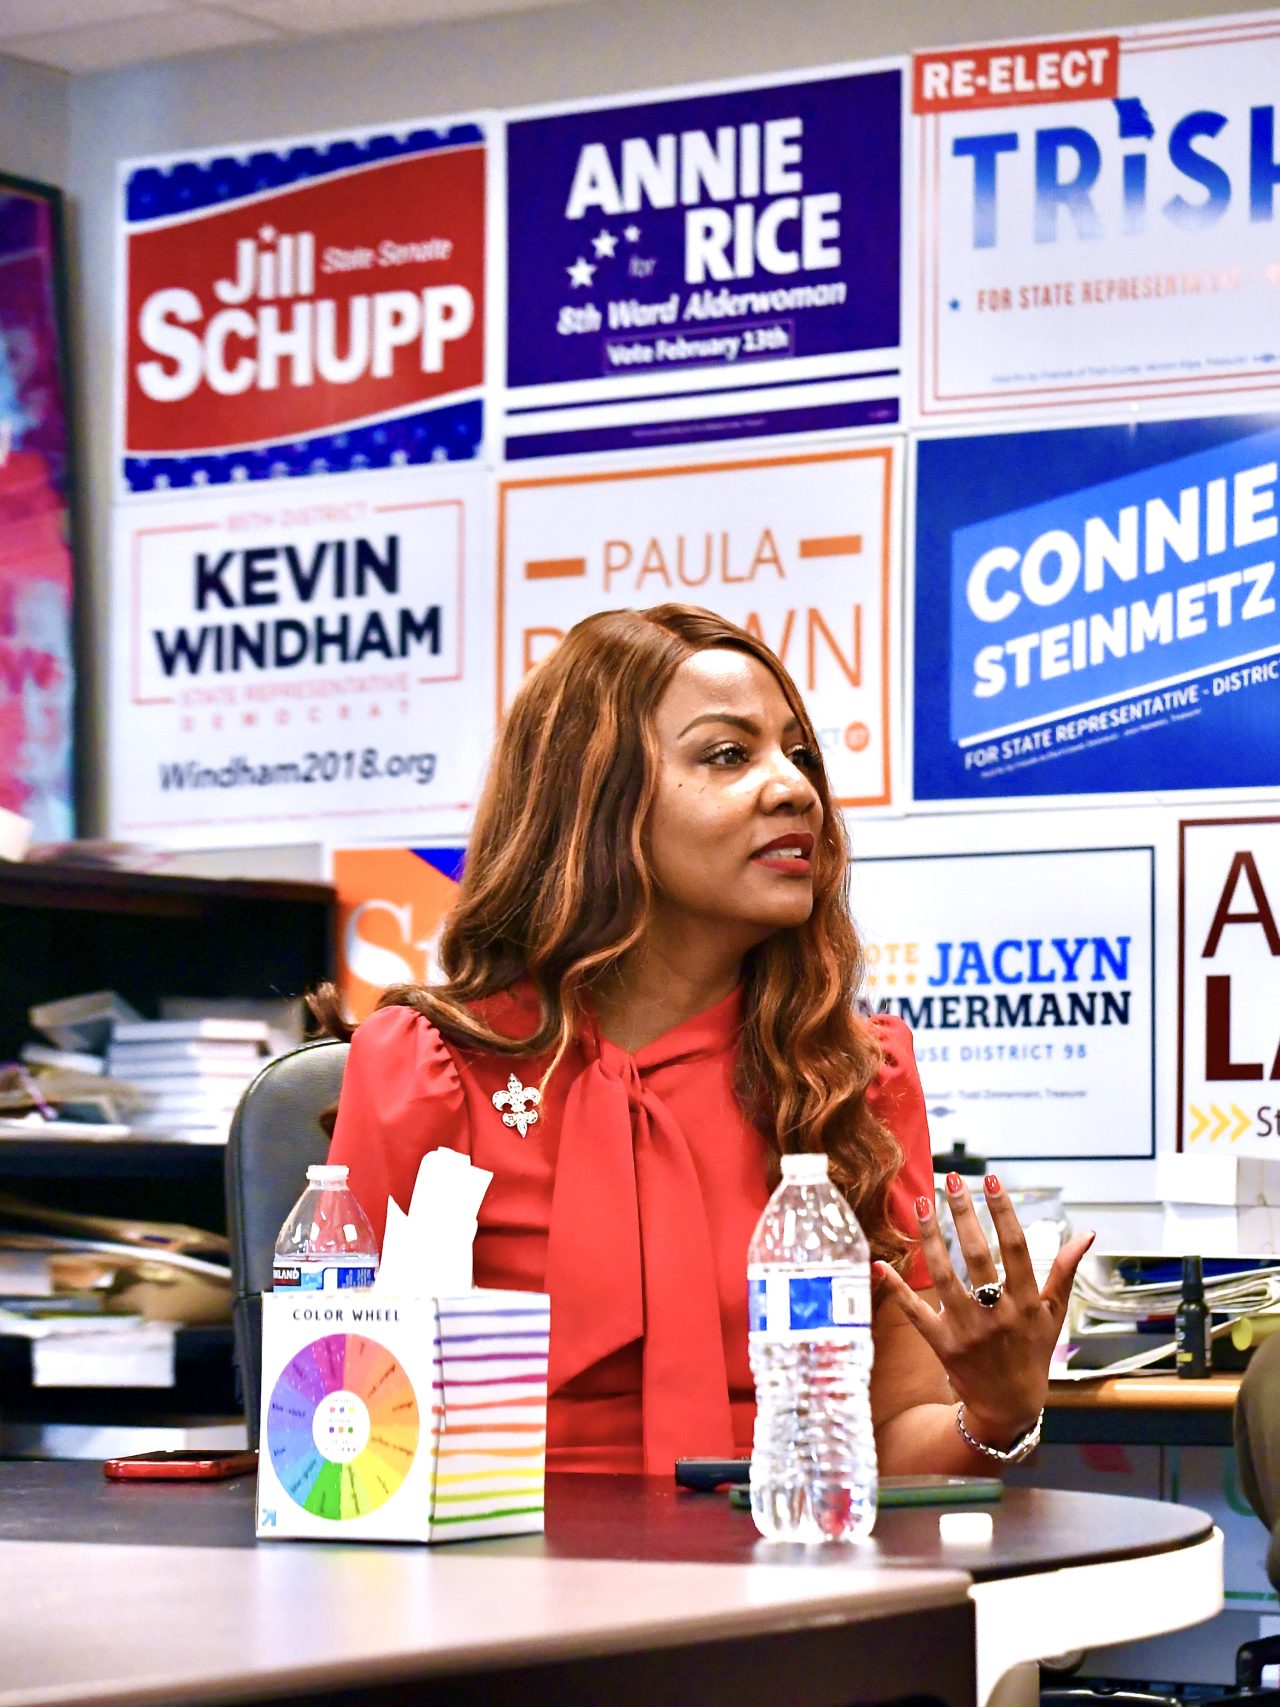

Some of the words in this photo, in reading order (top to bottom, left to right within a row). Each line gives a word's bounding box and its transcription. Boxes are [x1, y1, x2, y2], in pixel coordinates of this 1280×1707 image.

[921, 48, 1109, 100] RE-ELECT
[565, 117, 803, 219] ANNIE
[213, 223, 316, 305] Jill
[321, 248, 375, 274] State
[377, 238, 454, 268] Senate
[685, 192, 841, 284] RICE
[556, 303, 602, 335] 8th
[607, 293, 680, 330] Ward
[683, 281, 847, 321] Alderwoman
[976, 288, 1013, 312] FOR
[1019, 282, 1074, 309] STATE
[136, 284, 475, 402] SCHUPP
[607, 343, 653, 366] Vote
[655, 334, 741, 362] February
[743, 326, 789, 352] 13th
[194, 535, 399, 612] KEVIN
[602, 528, 786, 593] PAULA
[966, 462, 1279, 623] CONNIE
[153, 605, 442, 677] WINDHAM
[973, 561, 1275, 698] STEINMETZ
[965, 745, 998, 771] FOR
[1002, 729, 1052, 760] STATE
[1055, 684, 1200, 743] REPRESENTATIVE
[158, 748, 437, 792] Windham2018.org
[864, 942, 919, 966] OTE
[927, 936, 1131, 987] JACLYN
[914, 1045, 949, 1062] USE
[960, 1043, 1054, 1061] DISTRICT
[1064, 1043, 1087, 1059] 98
[292, 1309, 343, 1322] COLOR
[352, 1308, 400, 1322] WHEEL
